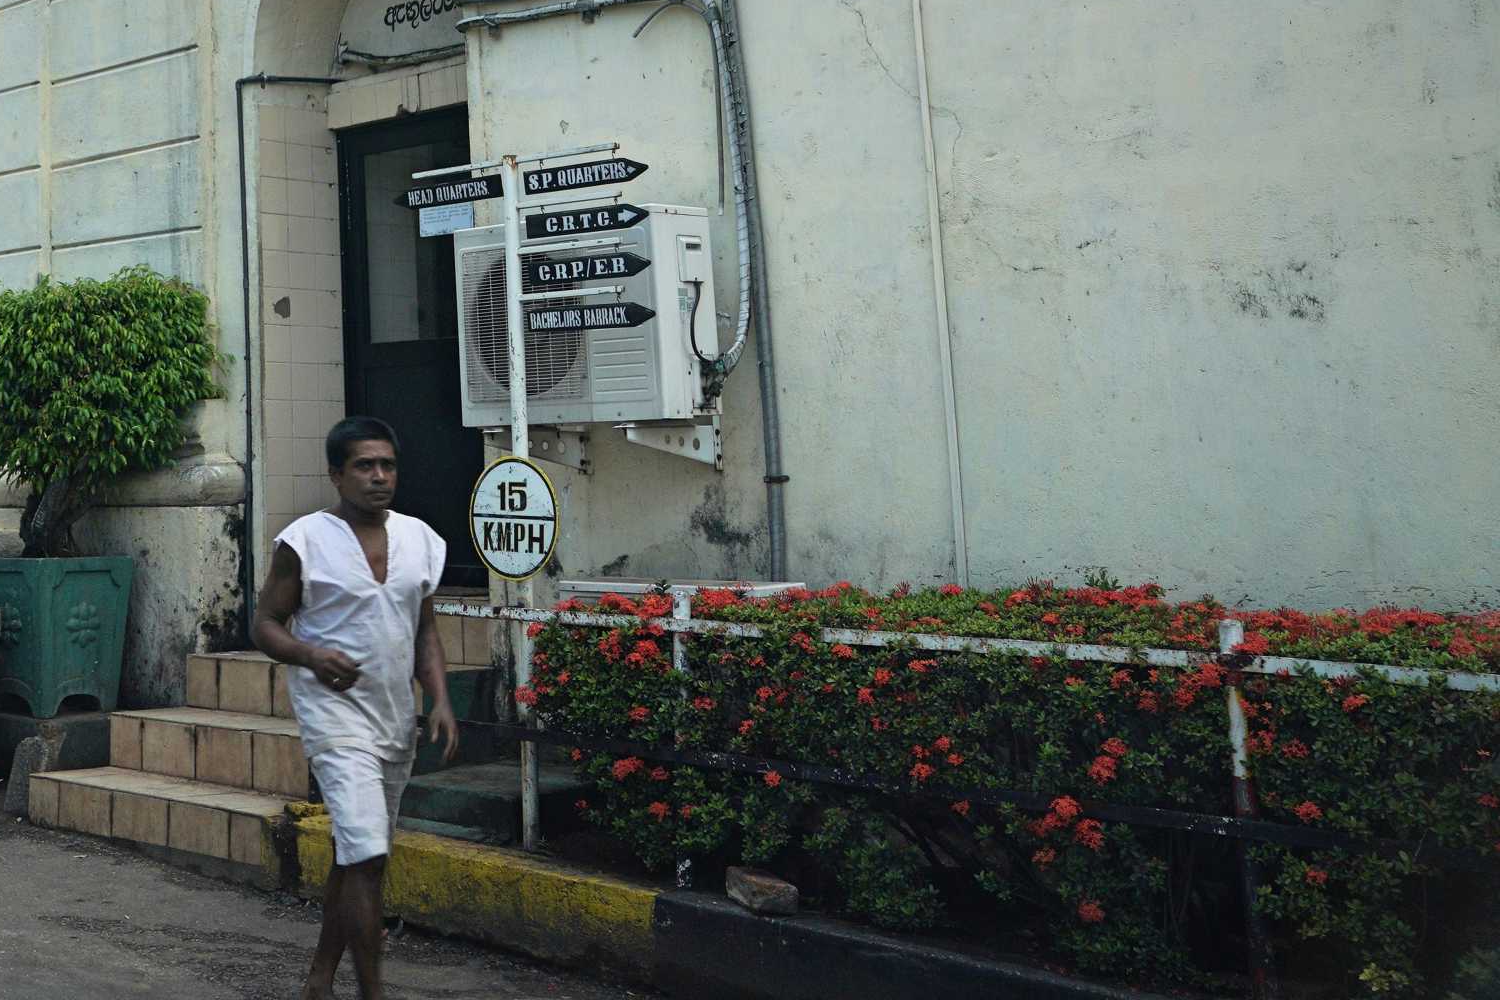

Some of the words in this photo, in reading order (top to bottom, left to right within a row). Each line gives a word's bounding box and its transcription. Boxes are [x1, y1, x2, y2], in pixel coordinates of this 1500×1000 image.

[408, 189, 434, 207] HEAD
[530, 309, 581, 330] BACHELORS
[497, 479, 528, 512] 15
